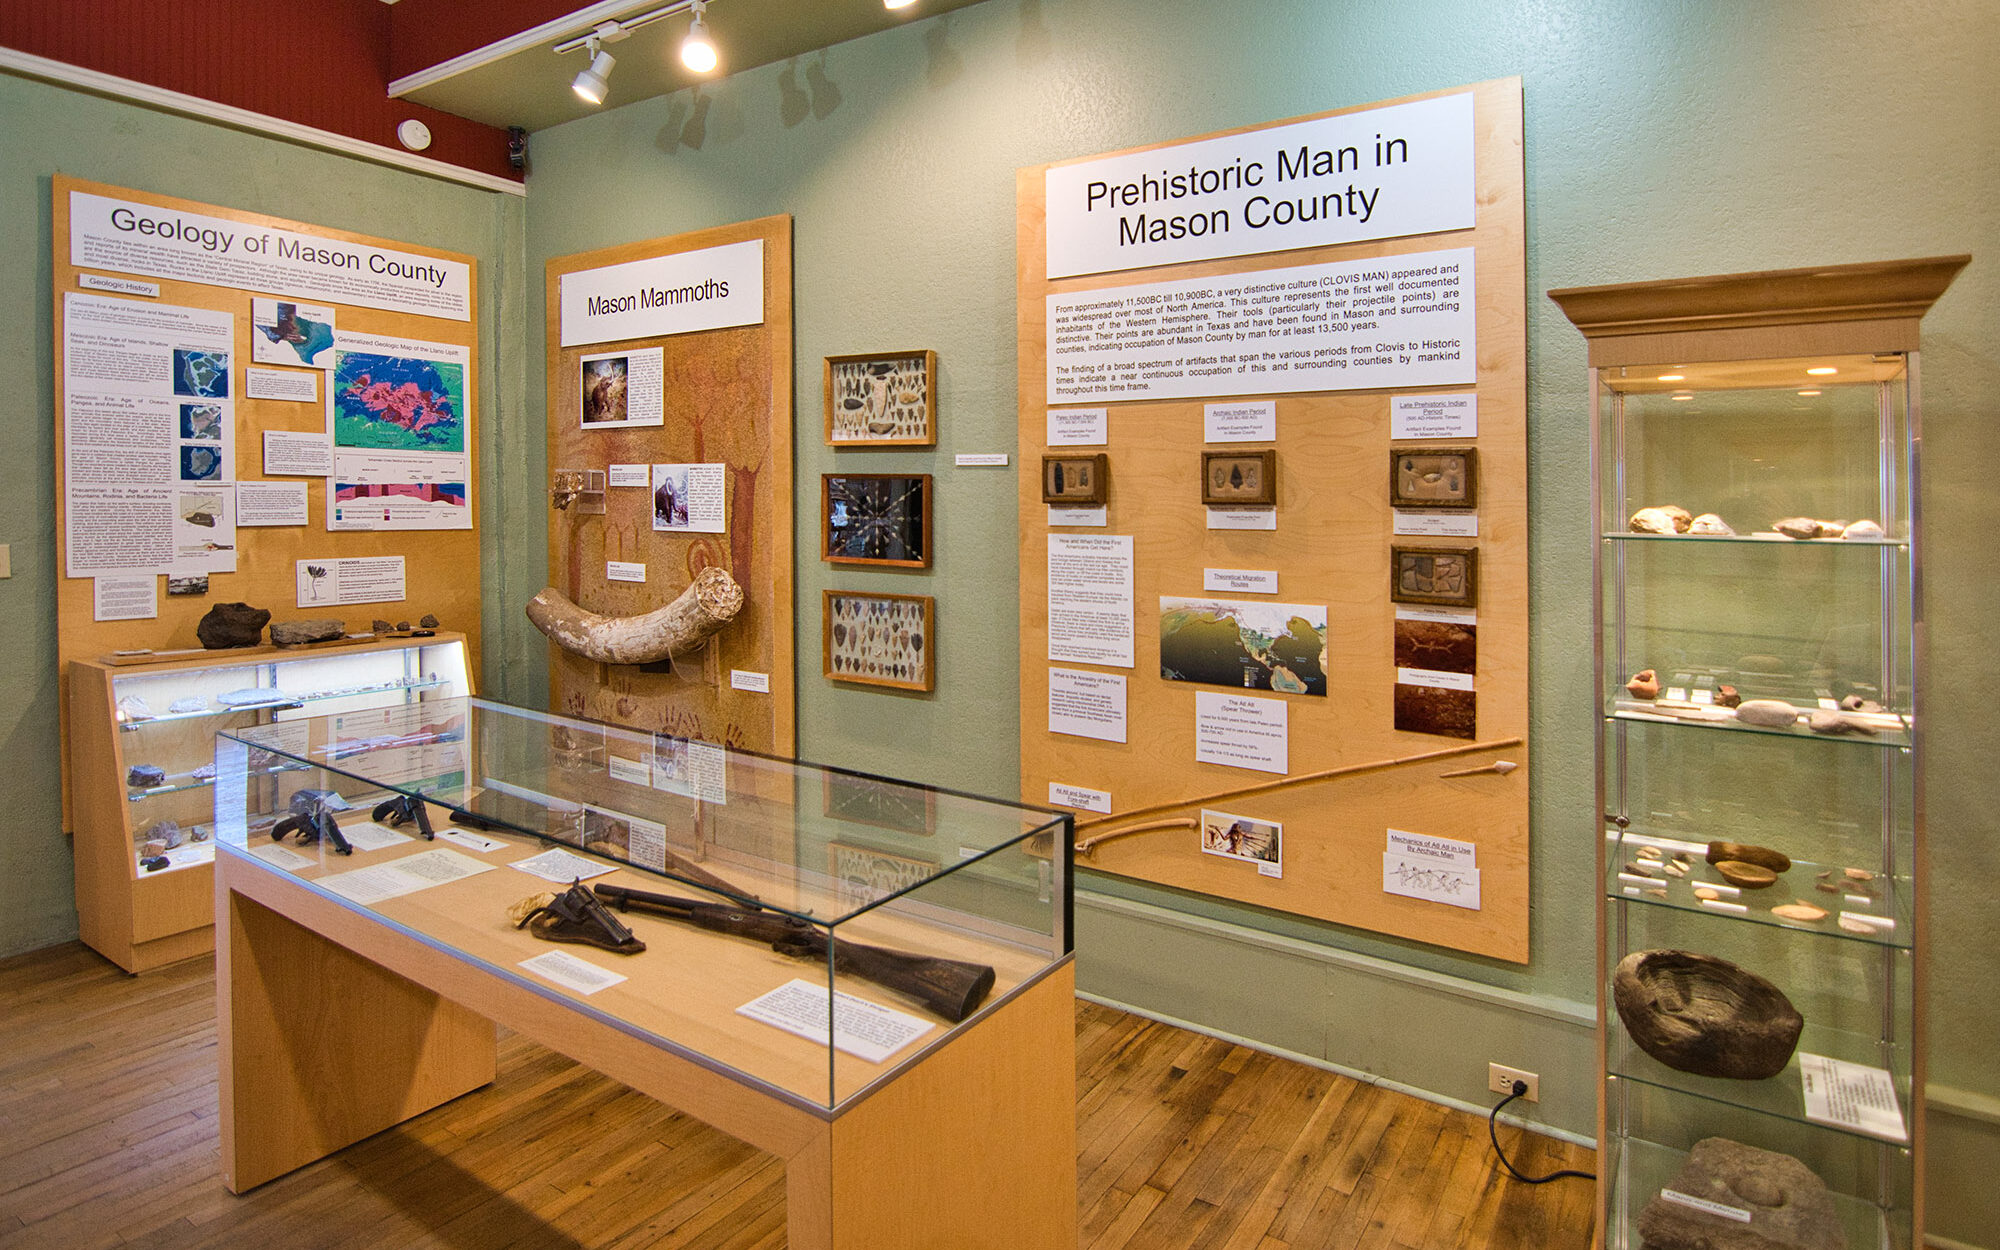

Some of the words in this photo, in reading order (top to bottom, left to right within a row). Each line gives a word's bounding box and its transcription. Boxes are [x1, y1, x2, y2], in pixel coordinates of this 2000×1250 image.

[1088, 158, 1263, 212] Prehistoric
[1278, 146, 1358, 182] Man
[1376, 134, 1407, 166] in
[1120, 209, 1229, 246] Mason
[1244, 184, 1380, 229] County
[111, 208, 234, 252] Geology
[244, 234, 270, 254] of
[278, 237, 360, 270] Mason
[369, 254, 446, 288] County
[89, 277, 124, 289] Geologic
[126, 283, 152, 294] History
[588, 295, 636, 316] Mason
[640, 278, 729, 308] Mammoths
[1055, 305, 1074, 313] From
[1074, 299, 1124, 313] approximately
[1163, 294, 1173, 302] till
[1224, 288, 1242, 297] very
[1243, 283, 1286, 294] distinctive
[1287, 280, 1318, 290] culture
[1319, 274, 1360, 289] (CLOVIS
[1362, 271, 1390, 282] MAN)
[1391, 266, 1438, 281] appeared
[1440, 264, 1459, 274] and
[1072, 311, 1112, 322] widespread
[1115, 310, 1132, 318] over
[1134, 307, 1153, 316] most
[1155, 305, 1164, 314] of
[1166, 303, 1188, 313] North
[1231, 298, 1248, 307] This
[1251, 295, 1280, 305] culture
[1284, 289, 1331, 303] represents
[1334, 288, 1350, 297] the
[1353, 285, 1371, 295] first
[1374, 283, 1394, 293] well
[1398, 276, 1459, 291] documented
[1055, 323, 1093, 333] inhabitants
[1097, 322, 1105, 330] of
[1109, 321, 1121, 329] the
[1125, 318, 1157, 327] Western
[1217, 310, 1238, 319] Their
[1243, 308, 1263, 317] tools
[1268, 303, 1320, 316] (particularly
[1325, 300, 1346, 309] their
[1352, 296, 1396, 309] projectile
[1402, 292, 1436, 304] points)
[1442, 291, 1459, 299] are
[1095, 331, 1114, 340] Their
[1116, 329, 1139, 340] points
[1156, 324, 1193, 335] abundant
[1196, 324, 1204, 332] in
[1207, 323, 1230, 331] Texas
[1233, 319, 1250, 329] and
[1252, 319, 1274, 327] have
[1276, 316, 1299, 325] been
[1302, 313, 1327, 323] found
[1330, 312, 1339, 320] in
[1343, 310, 1375, 319] Mason
[1378, 307, 1396, 316] and
[1400, 302, 1460, 314] surrounding
[374, 341, 400, 349] Geologic
[400, 343, 412, 351] Map
[1088, 341, 1123, 351] indicating
[1124, 338, 1165, 349] occupation
[1166, 337, 1175, 345] of
[1176, 336, 1203, 344] Mason
[1204, 332, 1234, 342] County
[1235, 331, 1246, 341] by
[1248, 331, 1267, 339] man
[1268, 329, 1281, 337] for
[1282, 327, 1291, 336] at
[1293, 325, 1315, 335] least
[1056, 366, 1069, 374] The
[1071, 365, 1095, 373] finding
[1097, 363, 1105, 371] of
[1114, 361, 1136, 370] broad
[1137, 360, 1173, 370] spectrum
[1175, 358, 1183, 366] of
[1185, 356, 1218, 365] artifacts
[1220, 354, 1236, 363] that
[1239, 355, 1259, 363] span
[1262, 352, 1276, 360] the
[1279, 350, 1311, 359] various
[1313, 347, 1348, 359] periods
[1350, 346, 1372, 354] from
[1375, 343, 1405, 353] Clovis
[1408, 342, 1419, 350] to
[1422, 340, 1460, 350] Historic
[1056, 376, 1075, 384] times
[1079, 373, 1107, 382] indicate
[1142, 370, 1184, 379] continuous
[1188, 366, 1232, 377] occupation
[1237, 364, 1246, 373] of
[1251, 363, 1267, 372] this
[1272, 361, 1289, 371] and
[1294, 358, 1347, 369] surrounding
[1353, 356, 1393, 366] counties
[1399, 354, 1411, 365] by
[1417, 351, 1460, 362] mankind
[1056, 384, 1093, 395] throughout
[1094, 384, 1108, 392] this
[1109, 383, 1125, 392] time
[1391, 835, 1423, 846] Mechanics
[1441, 850, 1454, 859] Man
